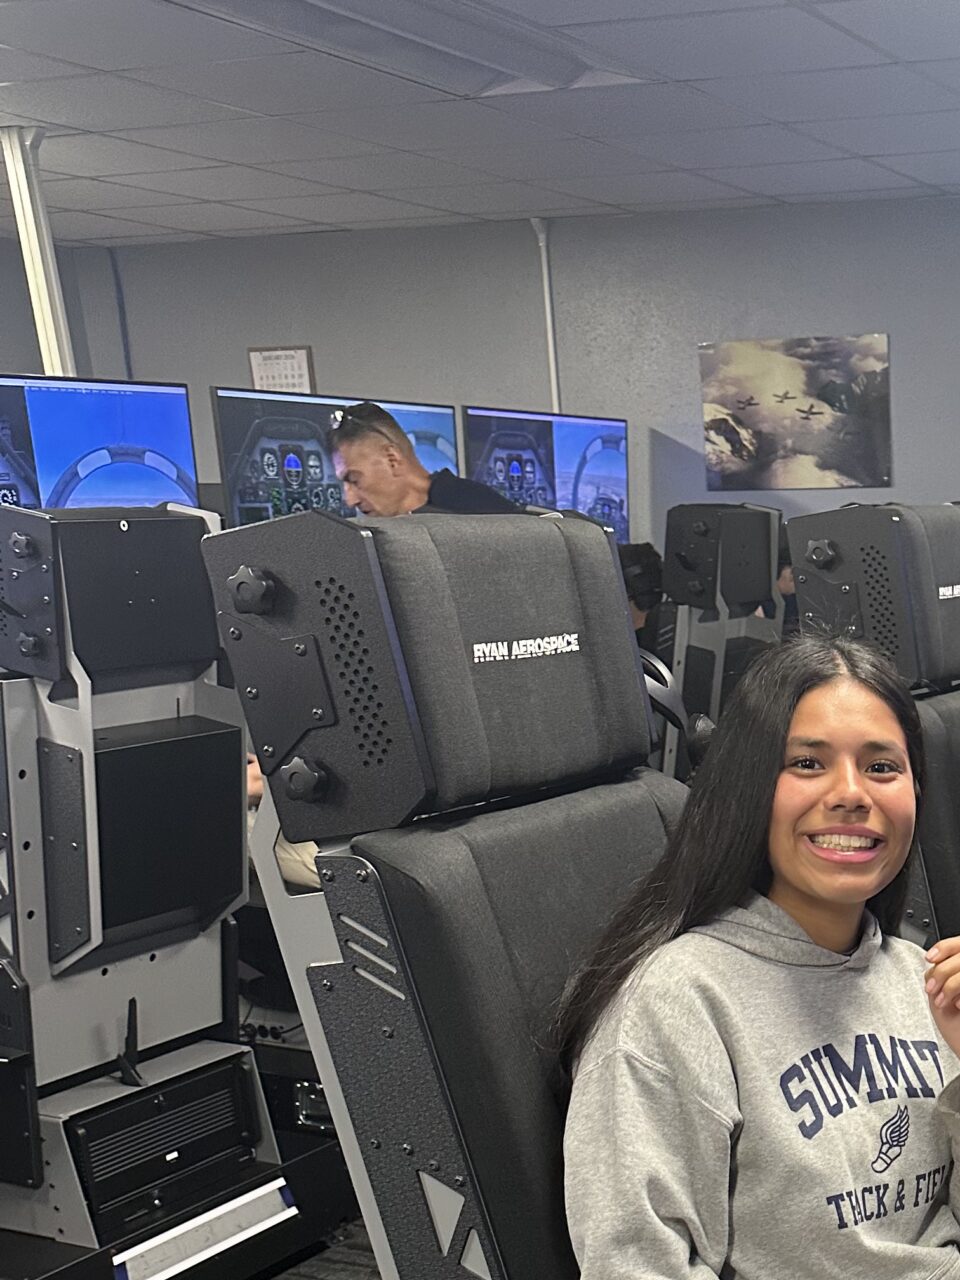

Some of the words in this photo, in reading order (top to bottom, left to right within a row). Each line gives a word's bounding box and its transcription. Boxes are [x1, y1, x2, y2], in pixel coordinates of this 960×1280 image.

[473, 641, 509, 663] RYAN
[510, 633, 580, 660] AEROSPACE
[780, 1033, 944, 1140] SUMMIT
[894, 1178, 906, 1214] &
[914, 1165, 946, 1207] FIE
